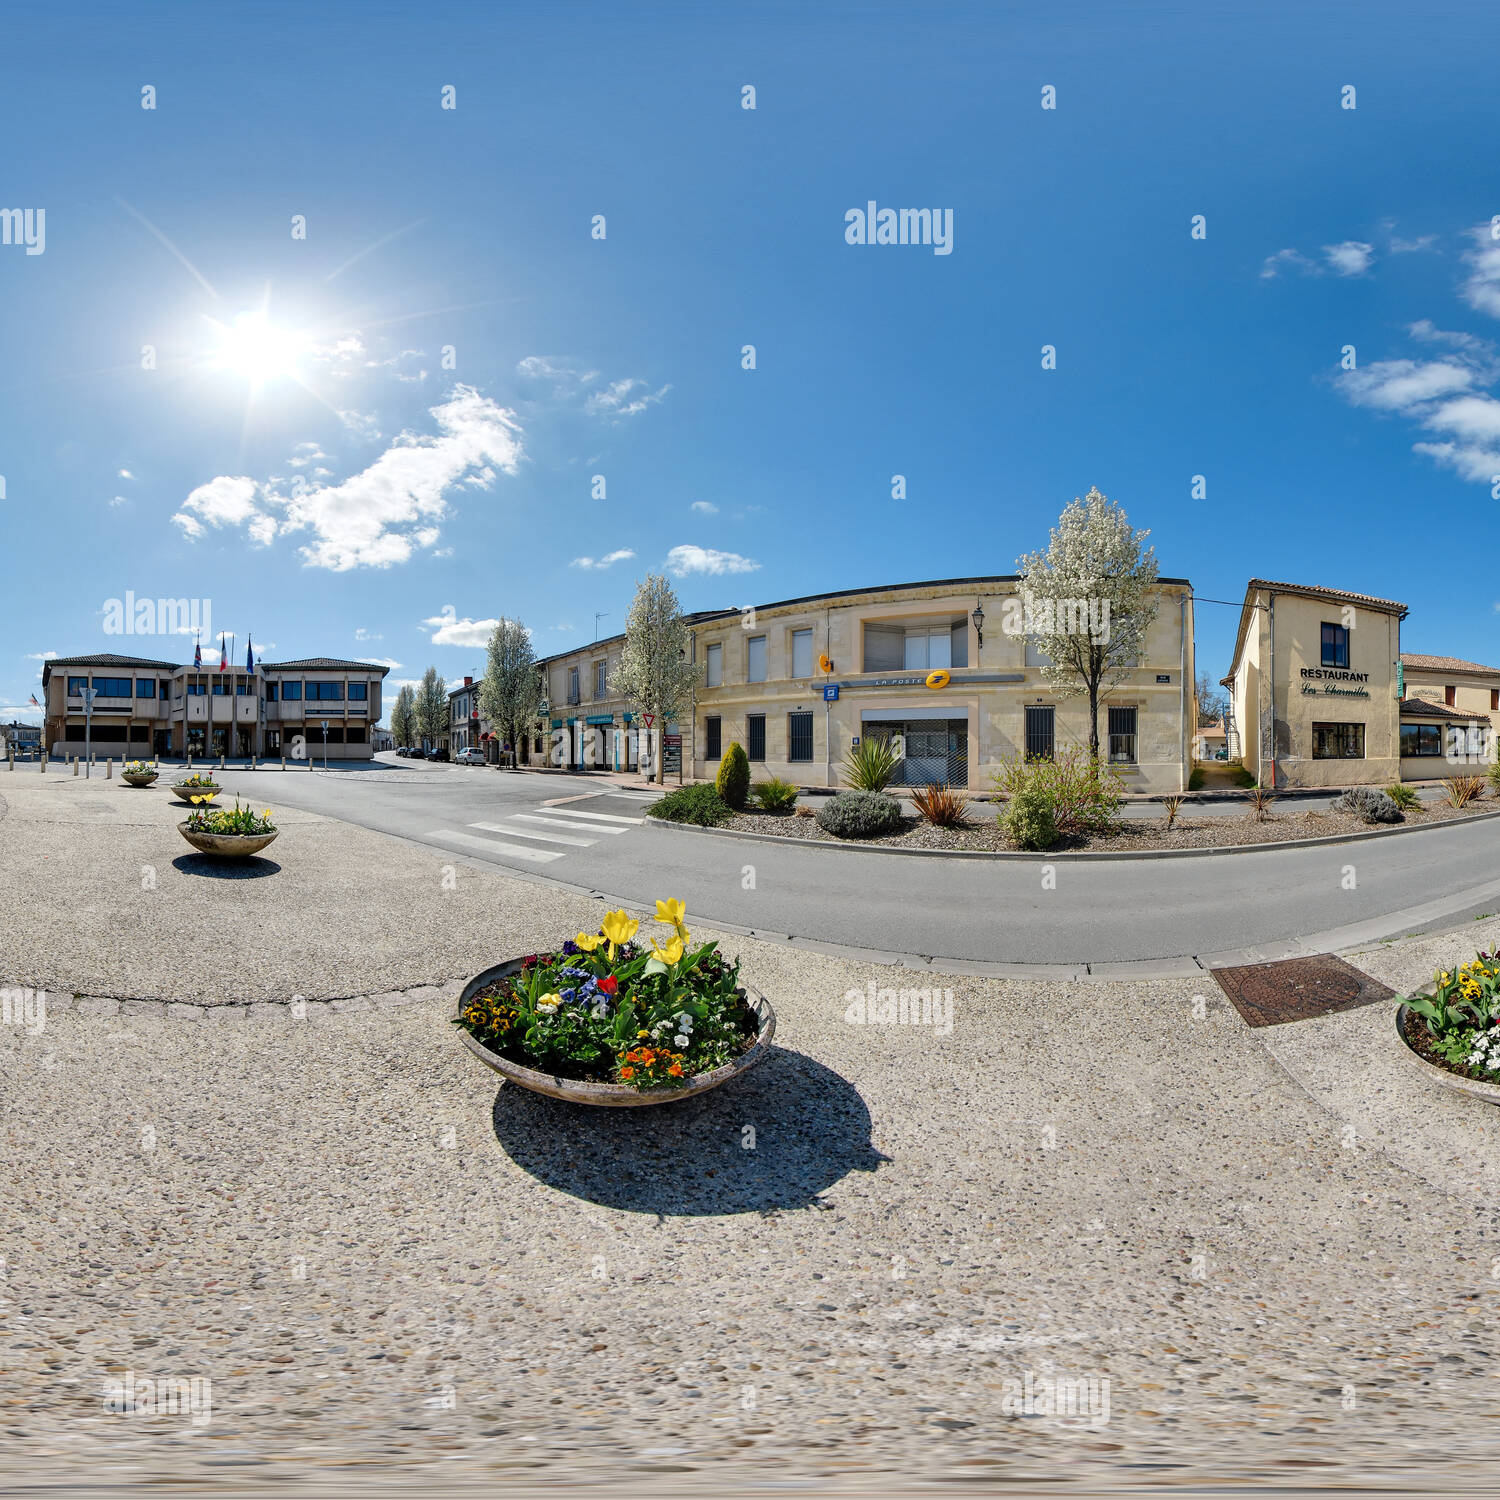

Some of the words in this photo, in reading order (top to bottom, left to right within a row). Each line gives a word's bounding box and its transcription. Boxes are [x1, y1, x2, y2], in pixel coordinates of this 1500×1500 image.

[1300, 668, 1369, 682] RESTAURANT
[1301, 682, 1316, 695] Les
[1324, 683, 1369, 697] Charmilles
